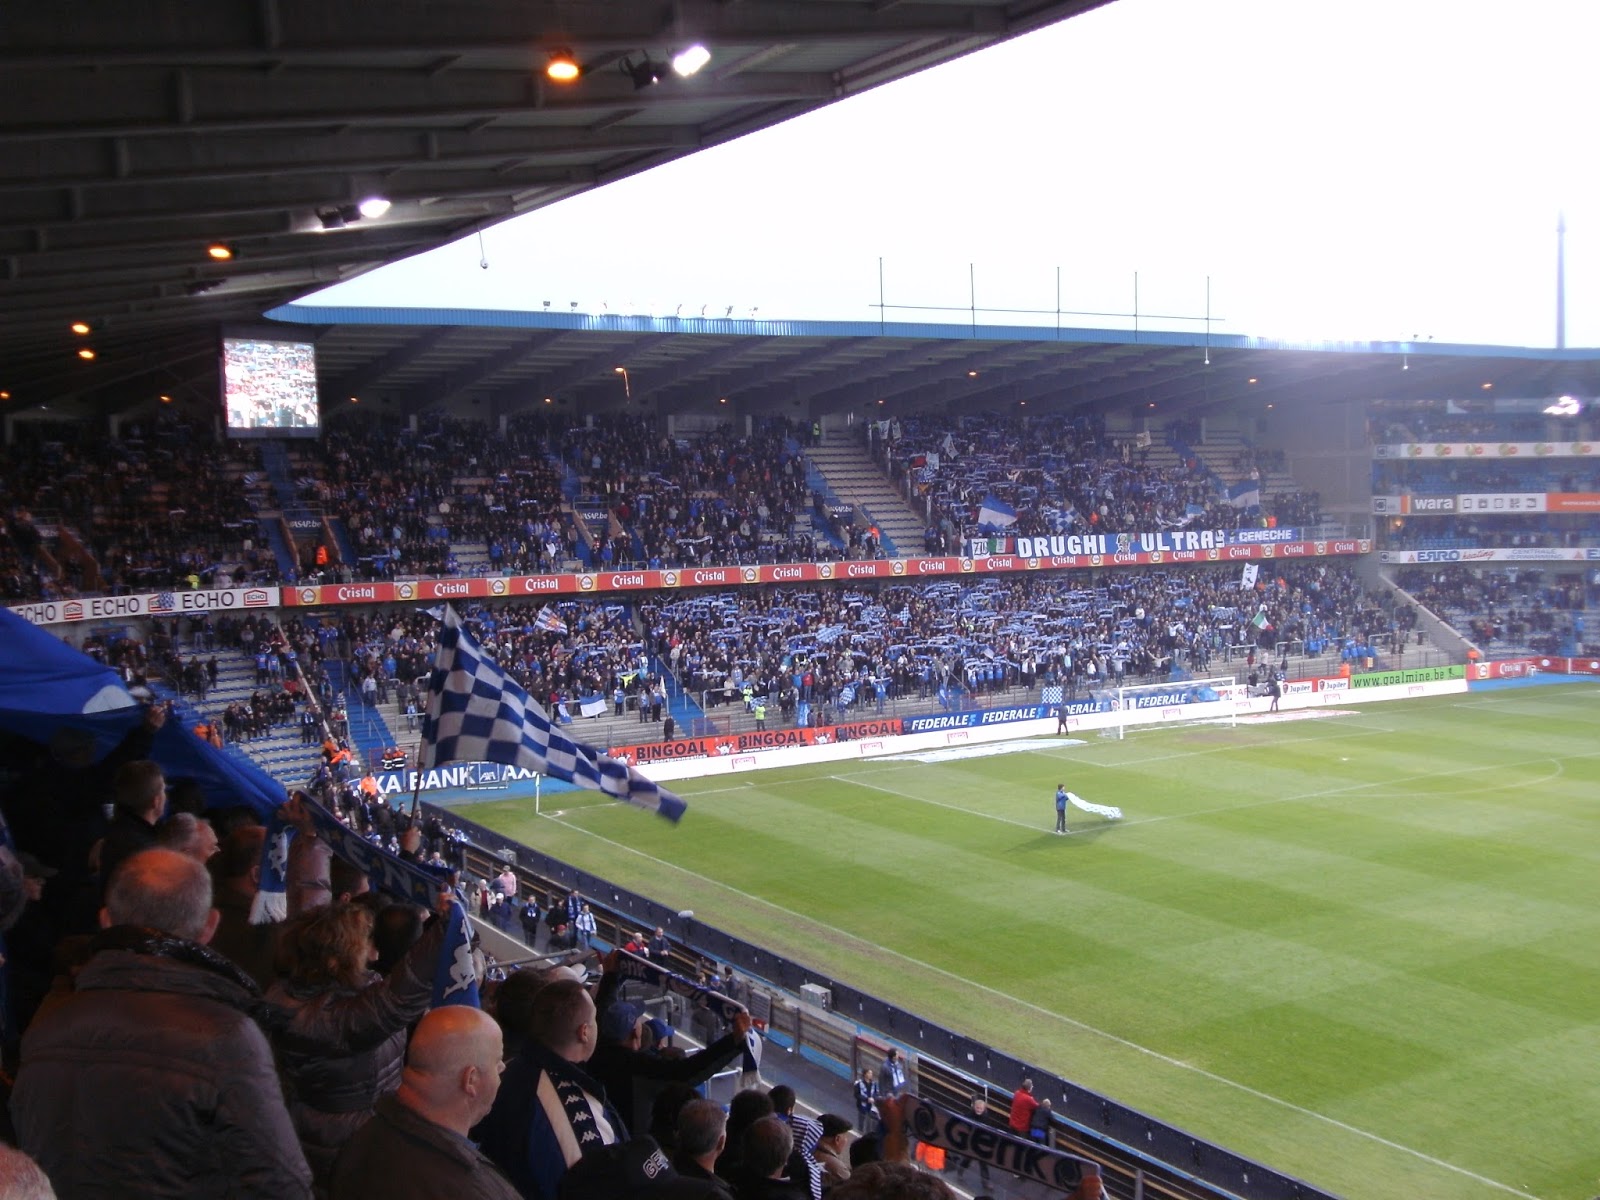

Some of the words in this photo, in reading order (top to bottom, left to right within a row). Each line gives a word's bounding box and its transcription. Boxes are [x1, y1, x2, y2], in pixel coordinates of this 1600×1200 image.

[1415, 498, 1454, 510] wara
[1017, 534, 1106, 558] DRUGHI
[1229, 547, 1251, 558] Cristal
[1283, 545, 1304, 555] Cristal
[1334, 542, 1354, 552] Cristal
[1052, 555, 1076, 566] Cristal
[1113, 552, 1137, 563] Cristal
[1173, 550, 1196, 560] Cristal
[848, 564, 876, 577] Cristal
[919, 560, 945, 573] Cristal
[986, 558, 1012, 570] Cristal
[694, 571, 725, 584] Cristal
[773, 567, 802, 580] Cristal
[525, 578, 559, 592] Cristal
[611, 575, 644, 588] Cristal
[338, 586, 375, 600] Cristal
[433, 583, 469, 597] Cristal
[92, 598, 140, 616] ECHO
[182, 592, 234, 609] ECHO
[1354, 668, 1444, 687] www.goalmine.be
[1290, 685, 1310, 693] Jupiler
[1327, 682, 1347, 690] Jupiler
[1138, 694, 1187, 707] FEDERALE
[982, 708, 1036, 723] FEDERALE
[911, 715, 969, 730] FEDERALE
[738, 731, 806, 749] BINGOAL
[636, 741, 707, 759] BINGOAL
[409, 765, 475, 790] BANK
